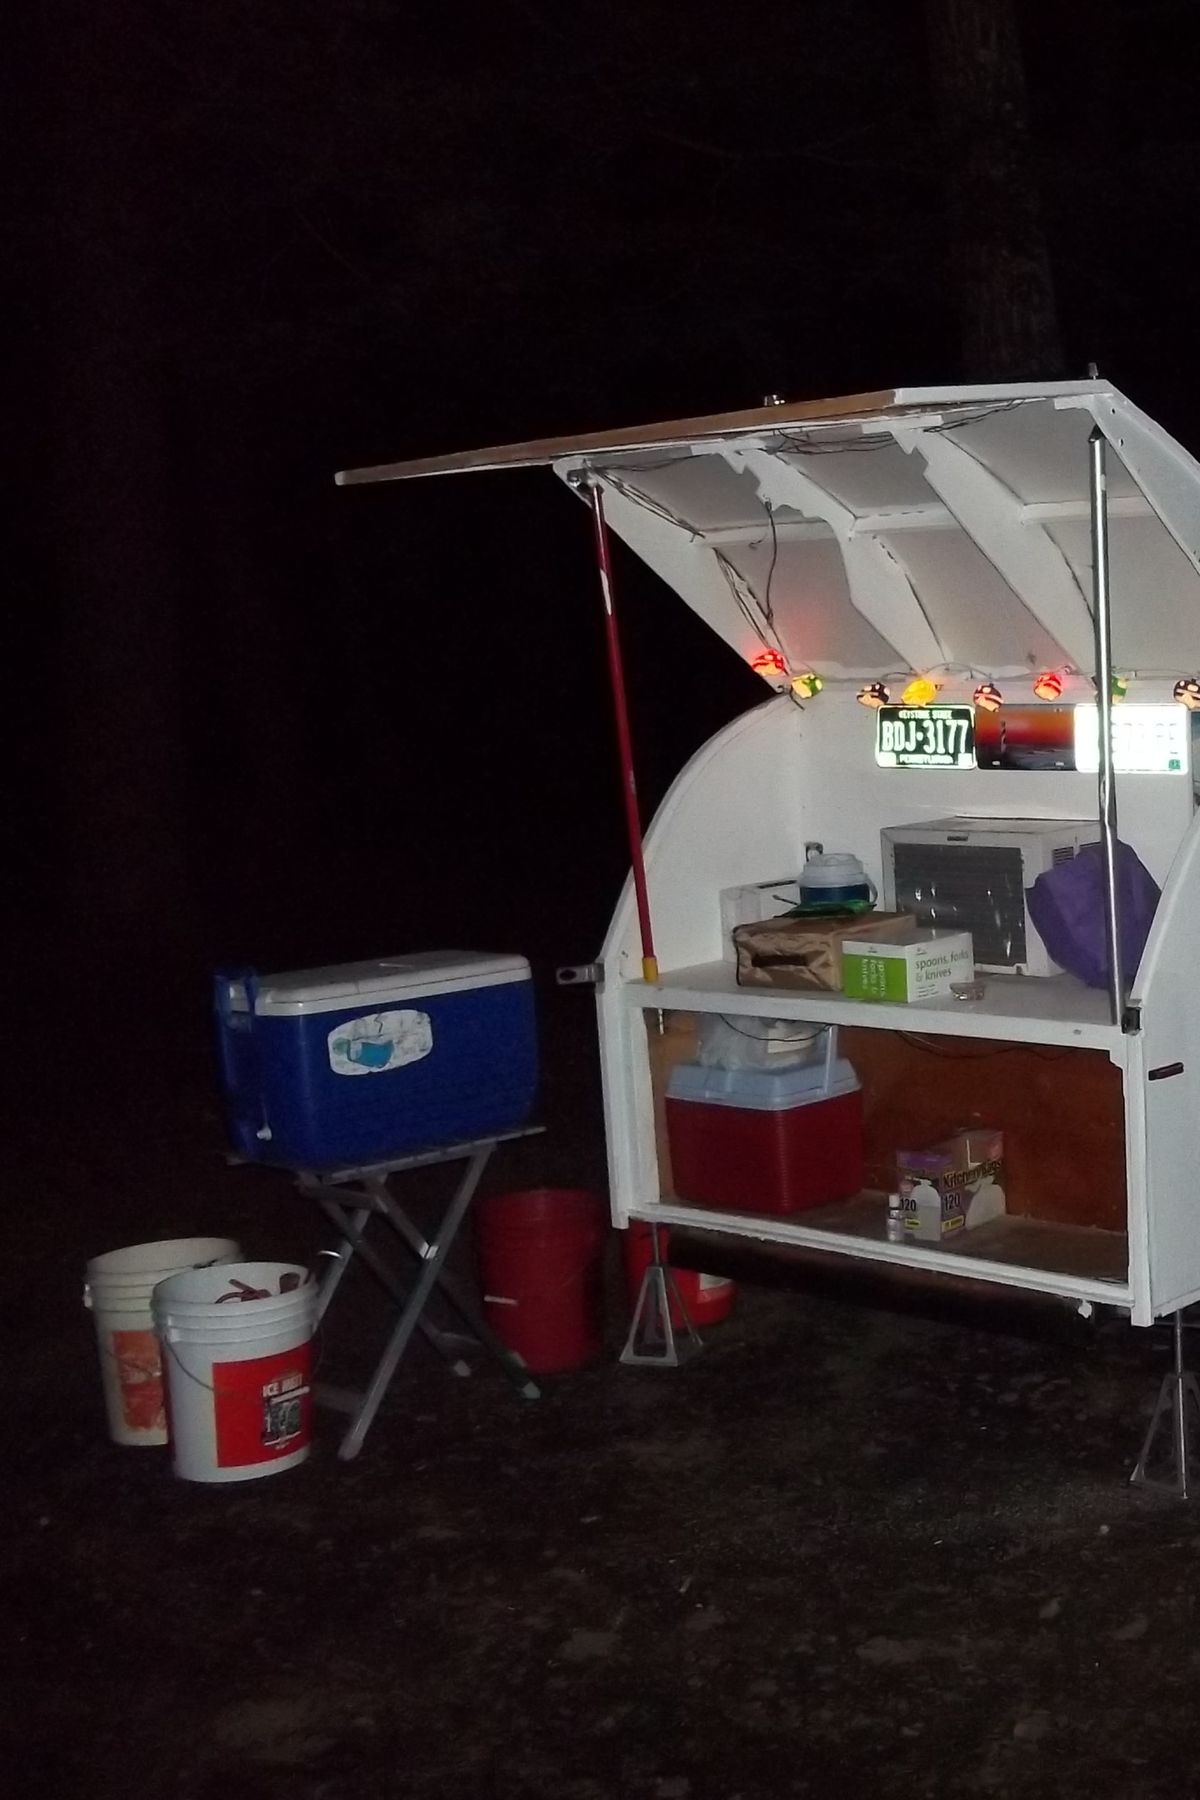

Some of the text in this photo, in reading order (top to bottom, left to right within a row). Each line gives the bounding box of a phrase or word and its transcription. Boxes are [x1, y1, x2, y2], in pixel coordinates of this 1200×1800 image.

[925, 968, 952, 980] knives
[901, 1198, 917, 1212] 120
[945, 1193, 960, 1211] 120
[263, 1383, 279, 1397] ICE
